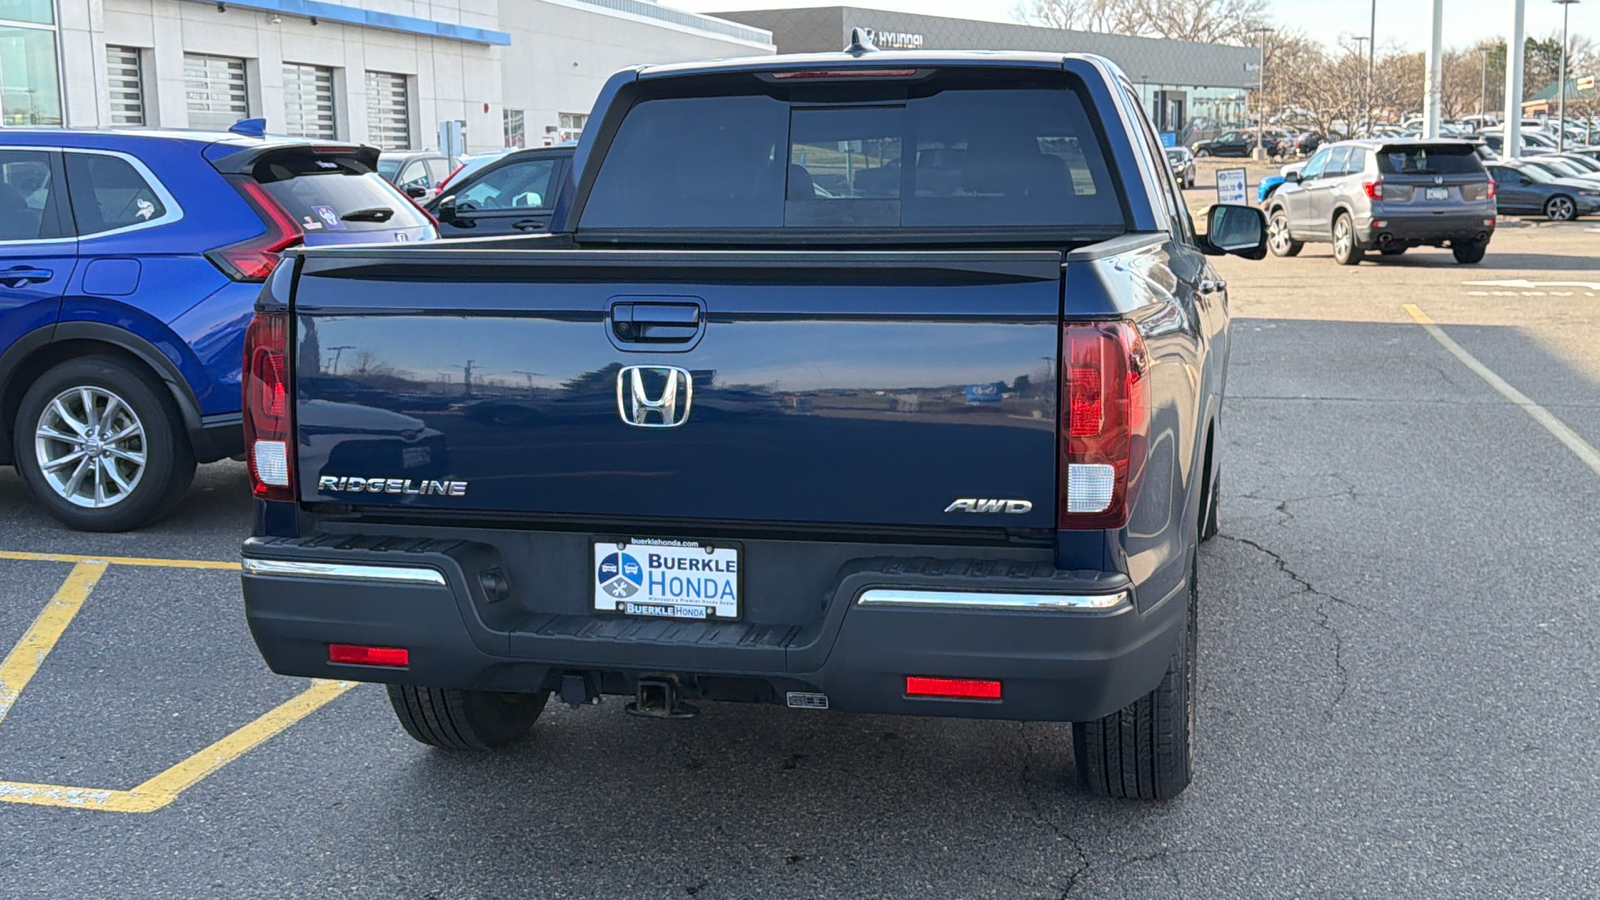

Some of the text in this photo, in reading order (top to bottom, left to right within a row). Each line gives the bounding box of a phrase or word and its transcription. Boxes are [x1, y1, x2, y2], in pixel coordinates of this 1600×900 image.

[879, 31, 923, 48] HYUNDAI
[318, 475, 468, 496] RIDGELINE
[943, 498, 1033, 514] AWD
[631, 537, 699, 547] buerklehonda.com
[648, 553, 736, 573] BUERKLE
[648, 570, 736, 600] HONDA
[626, 603, 704, 617] BUERKLE HONDA
